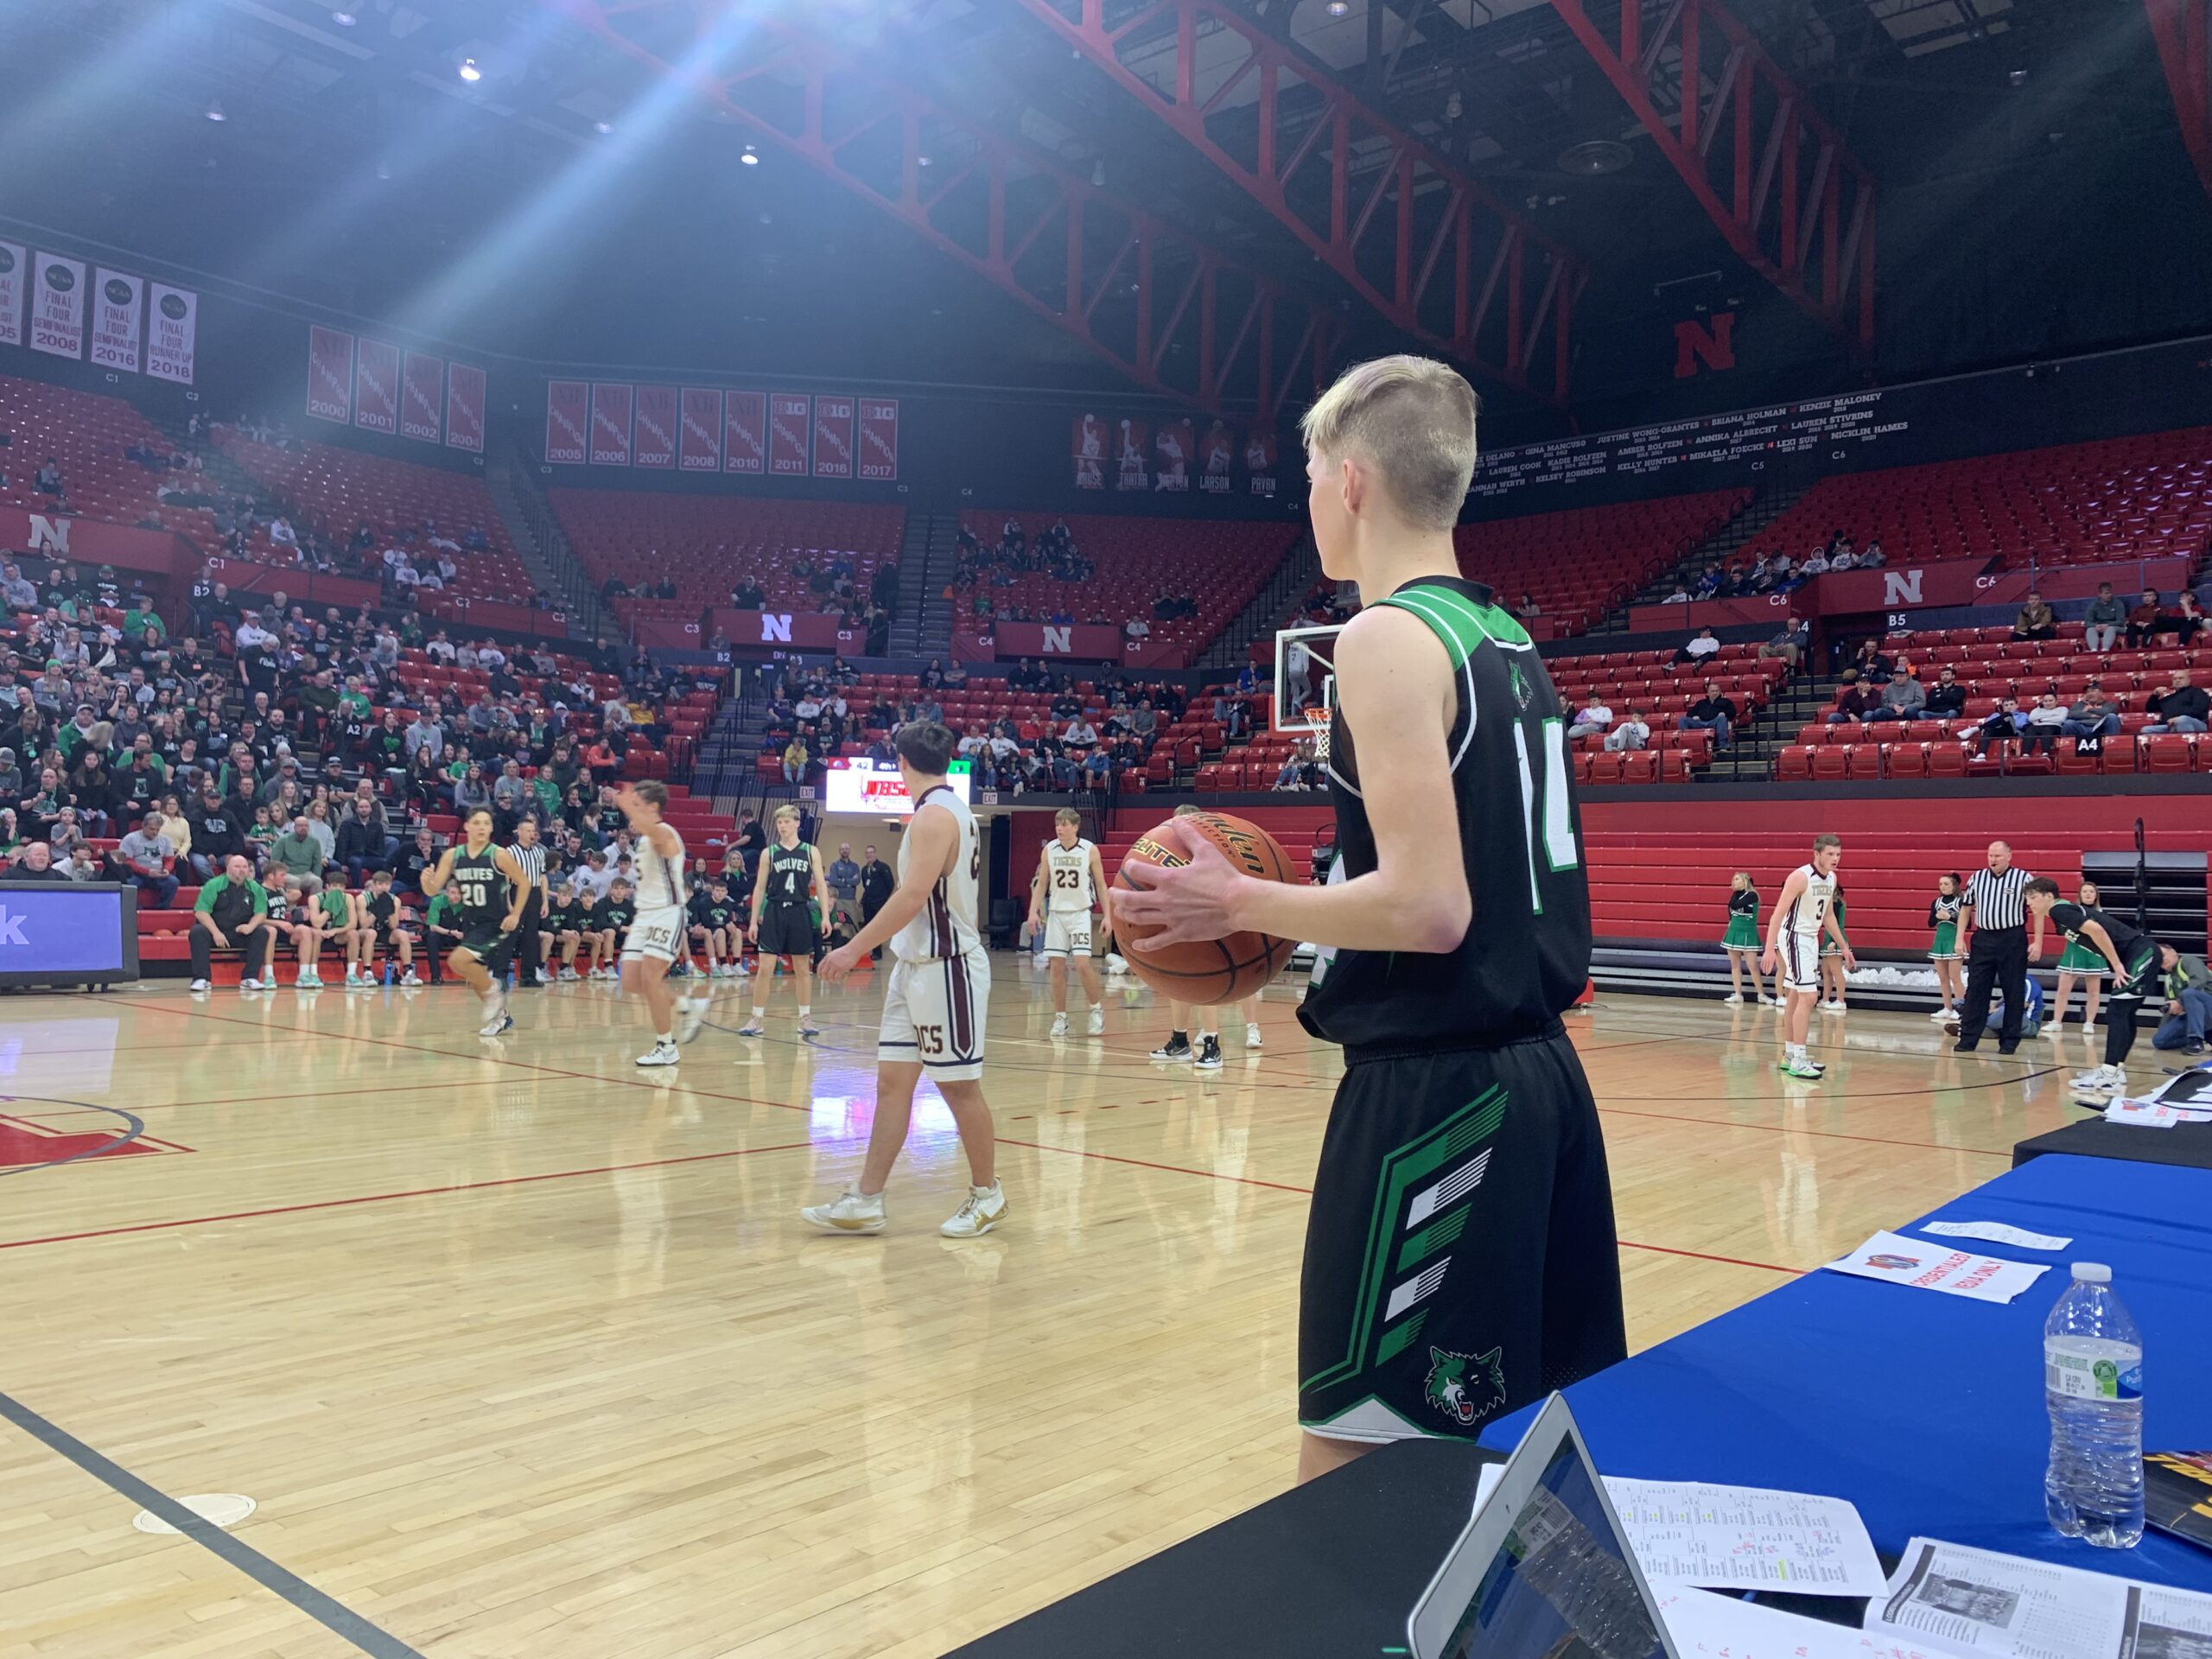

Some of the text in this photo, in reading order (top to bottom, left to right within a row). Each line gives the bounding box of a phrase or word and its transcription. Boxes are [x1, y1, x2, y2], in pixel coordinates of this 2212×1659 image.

[45, 290, 73, 309] FINAL
[47, 305, 70, 322] FOUR
[105, 306, 130, 324] FINAL
[105, 321, 128, 337] FOUR
[160, 320, 184, 337] FINAL
[36, 332, 78, 352] 2008
[162, 334, 183, 351] FOUR
[1673, 312, 1735, 378] N
[96, 346, 136, 365] 2016
[149, 344, 193, 364] RUNNER UP
[151, 359, 190, 378] 2018
[105, 373, 118, 383] C1
[186, 391, 200, 401] C2
[310, 398, 346, 418] 2000
[359, 410, 392, 429] 2001
[1525, 447, 1545, 455] GINA
[1547, 439, 1586, 452] MANCUSO
[1597, 432, 1630, 445] JUSTINE
[1711, 414, 1745, 427] BRIANA
[1746, 408, 1787, 420] HOLMAN
[1799, 400, 1833, 413] KENZIE
[1834, 392, 1882, 407] MALONEY
[404, 422, 437, 440] 2002
[449, 431, 480, 448] 2004
[1489, 465, 1517, 476] LAUREN
[1520, 461, 1541, 471] COOK
[1548, 456, 1571, 467] KADIE
[1573, 451, 1607, 463] ROLFZEN
[1618, 445, 1645, 456] AMBER
[1647, 439, 1683, 451] ROLFZEN
[1694, 432, 1731, 444] ANNIKA
[1732, 424, 1779, 438] ALBRECHT
[1791, 416, 1827, 430] LAUREN
[1829, 410, 1873, 424] STIVRINS
[550, 448, 582, 460] 2005
[594, 450, 626, 462] 2006
[638, 453, 671, 465] 2007
[683, 455, 715, 467] 2008
[1468, 481, 1497, 493] ANNAH
[1499, 478, 1526, 489] WERTH
[1535, 472, 1565, 483] KELSEY
[1566, 466, 1607, 479] ROBINSON
[1618, 461, 1642, 472] KELLY
[1644, 455, 1678, 467] HUNTER
[1689, 448, 1728, 461] MIKAELA
[1730, 442, 1764, 454] FOECKE
[1777, 438, 1796, 448] LEXI
[1799, 435, 1818, 445] SUN
[1830, 426, 1871, 440] NICKLIN
[1873, 421, 1909, 435] HAMES
[1831, 450, 1847, 460] C6
[728, 457, 760, 470] 2010
[774, 459, 804, 471] 2011
[817, 462, 848, 474] 2016
[863, 464, 892, 477] 2017
[1751, 461, 1764, 471] C5
[1199, 475, 1230, 491] LARSON
[1250, 476, 1276, 492] PAVAN
[28, 513, 71, 554] N
[208, 557, 225, 569] C1
[1884, 569, 1923, 606] N
[1976, 575, 1996, 588] C6
[194, 585, 210, 597] B2
[455, 596, 471, 608] C2
[1770, 594, 1788, 606] C6
[551, 612, 566, 623] C2
[1888, 613, 1907, 626] B5
[684, 623, 700, 634] C3
[761, 613, 793, 642] N
[837, 630, 853, 641] C3
[978, 637, 994, 646] C4
[1042, 626, 1071, 653] N
[1126, 642, 1141, 652] C4
[716, 652, 731, 663] B2
[346, 723, 360, 735] A2
[2078, 740, 2099, 751] A4
[856, 761, 868, 770] 42
[801, 787, 815, 798] EXIT
[983, 793, 997, 804] EXIT
[1132, 837, 1185, 868] ELITE
[773, 857, 809, 873] WOLVES
[1053, 855, 1082, 867] TIGERS
[454, 867, 494, 881] WOLVES
[1055, 869, 1079, 888] 23
[785, 872, 795, 893] 4
[461, 883, 487, 907] 20
[1816, 899, 1824, 920] 3
